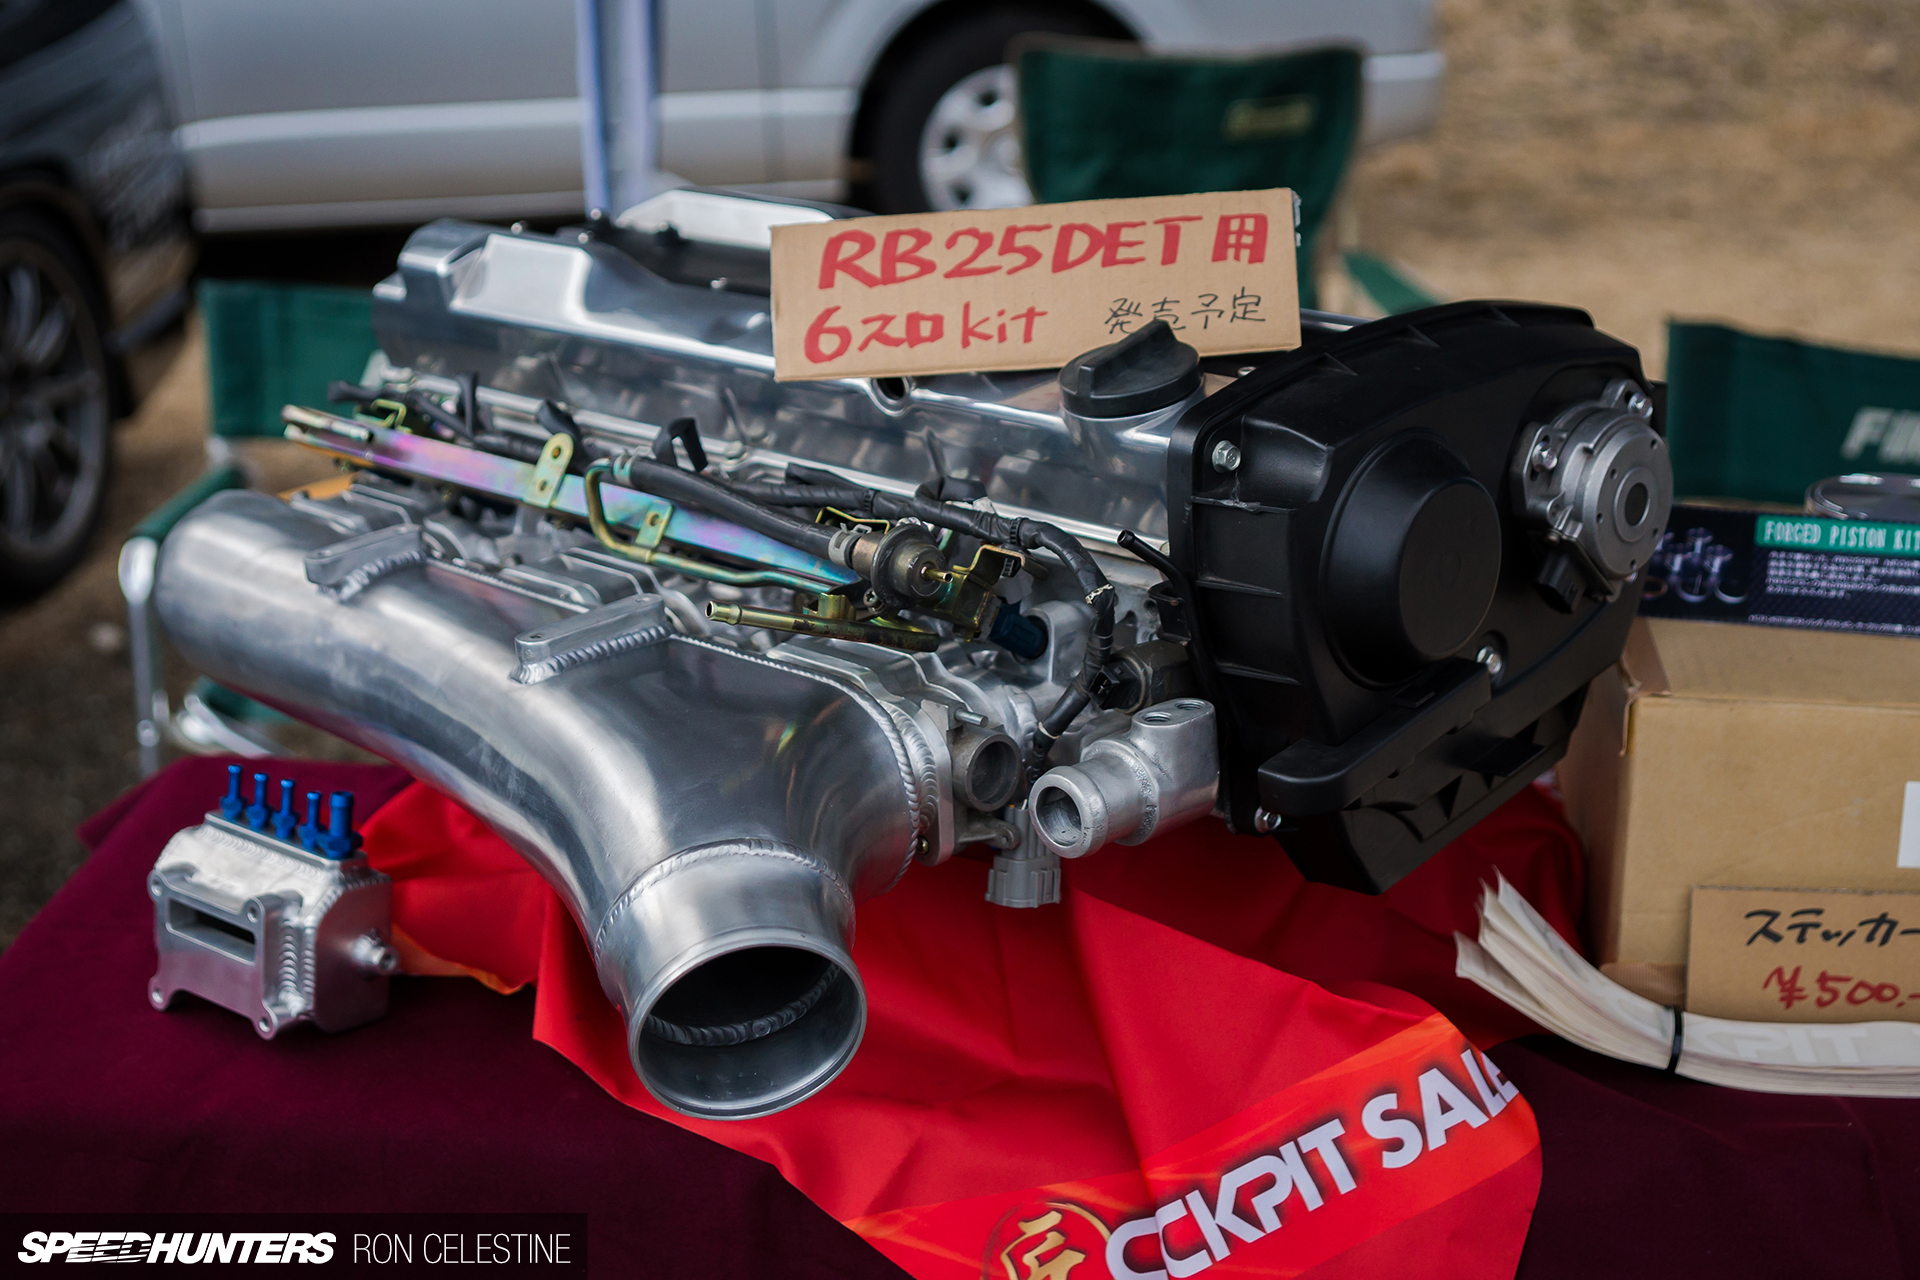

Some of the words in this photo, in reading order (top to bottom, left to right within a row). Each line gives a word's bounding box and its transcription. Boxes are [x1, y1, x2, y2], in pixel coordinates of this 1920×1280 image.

[803, 304, 946, 366] 6スロ
[959, 300, 1049, 351] kit
[1763, 519, 1823, 546] FORGED
[1829, 524, 1888, 549] PISTON
[1892, 528, 1920, 552] KIT
